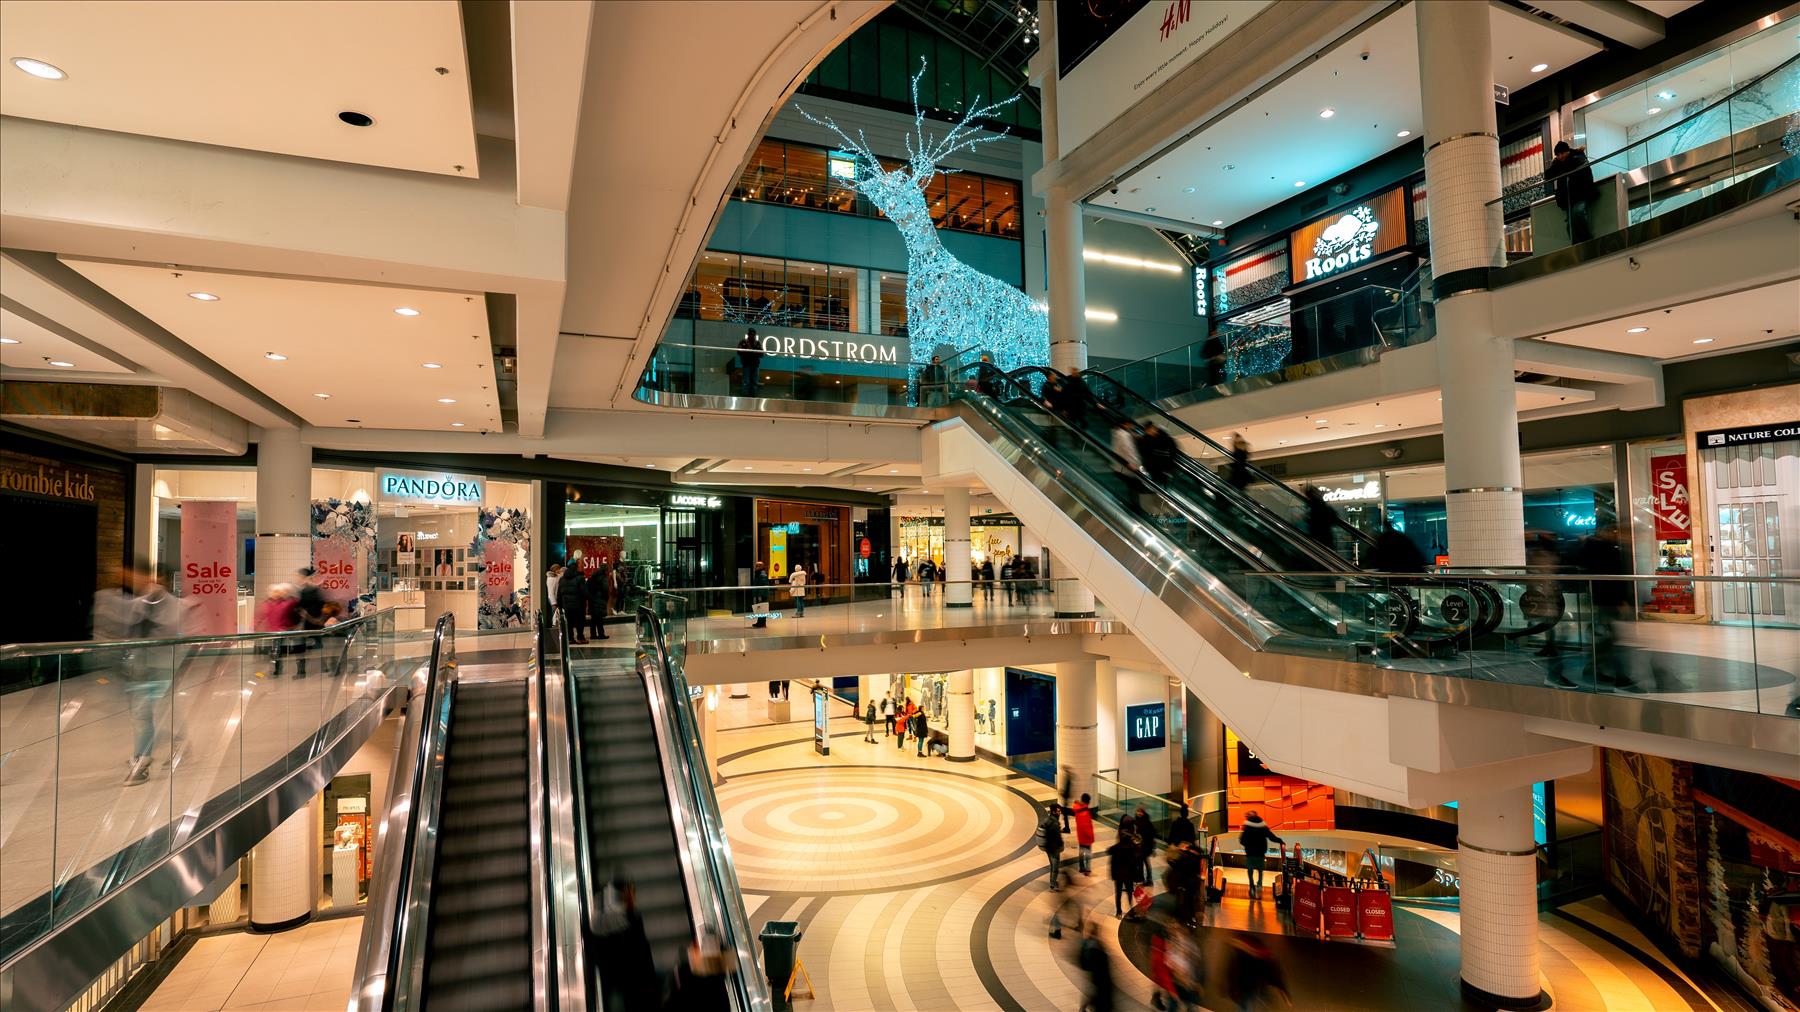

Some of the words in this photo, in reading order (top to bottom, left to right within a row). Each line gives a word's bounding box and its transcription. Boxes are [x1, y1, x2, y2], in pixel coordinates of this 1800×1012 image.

[1159, 0, 1191, 43] H&M
[1133, 79, 1146, 91] Enjoy
[1145, 70, 1157, 81] every
[1157, 61, 1168, 73] little
[1188, 35, 1205, 48] Happy
[1305, 240, 1371, 280] Roots
[1195, 266, 1207, 316] Roots
[1728, 430, 1771, 442] NATURE
[64, 470, 95, 501] kids
[386, 477, 480, 498] PANDORA
[672, 495, 707, 506] LACOSTE
[1660, 471, 1691, 530] SALE
[986, 534, 1002, 553] free
[187, 561, 232, 578] Sale
[318, 560, 354, 575] Sale
[486, 561, 512, 573] Sale
[192, 583, 227, 595] 50%
[323, 579, 350, 590] 50%
[488, 577, 509, 586] 50%
[1389, 612, 1398, 627] 2
[1451, 607, 1460, 621] 2
[1136, 716, 1159, 739] GAP
[1300, 898, 1316, 908] CLOSED
